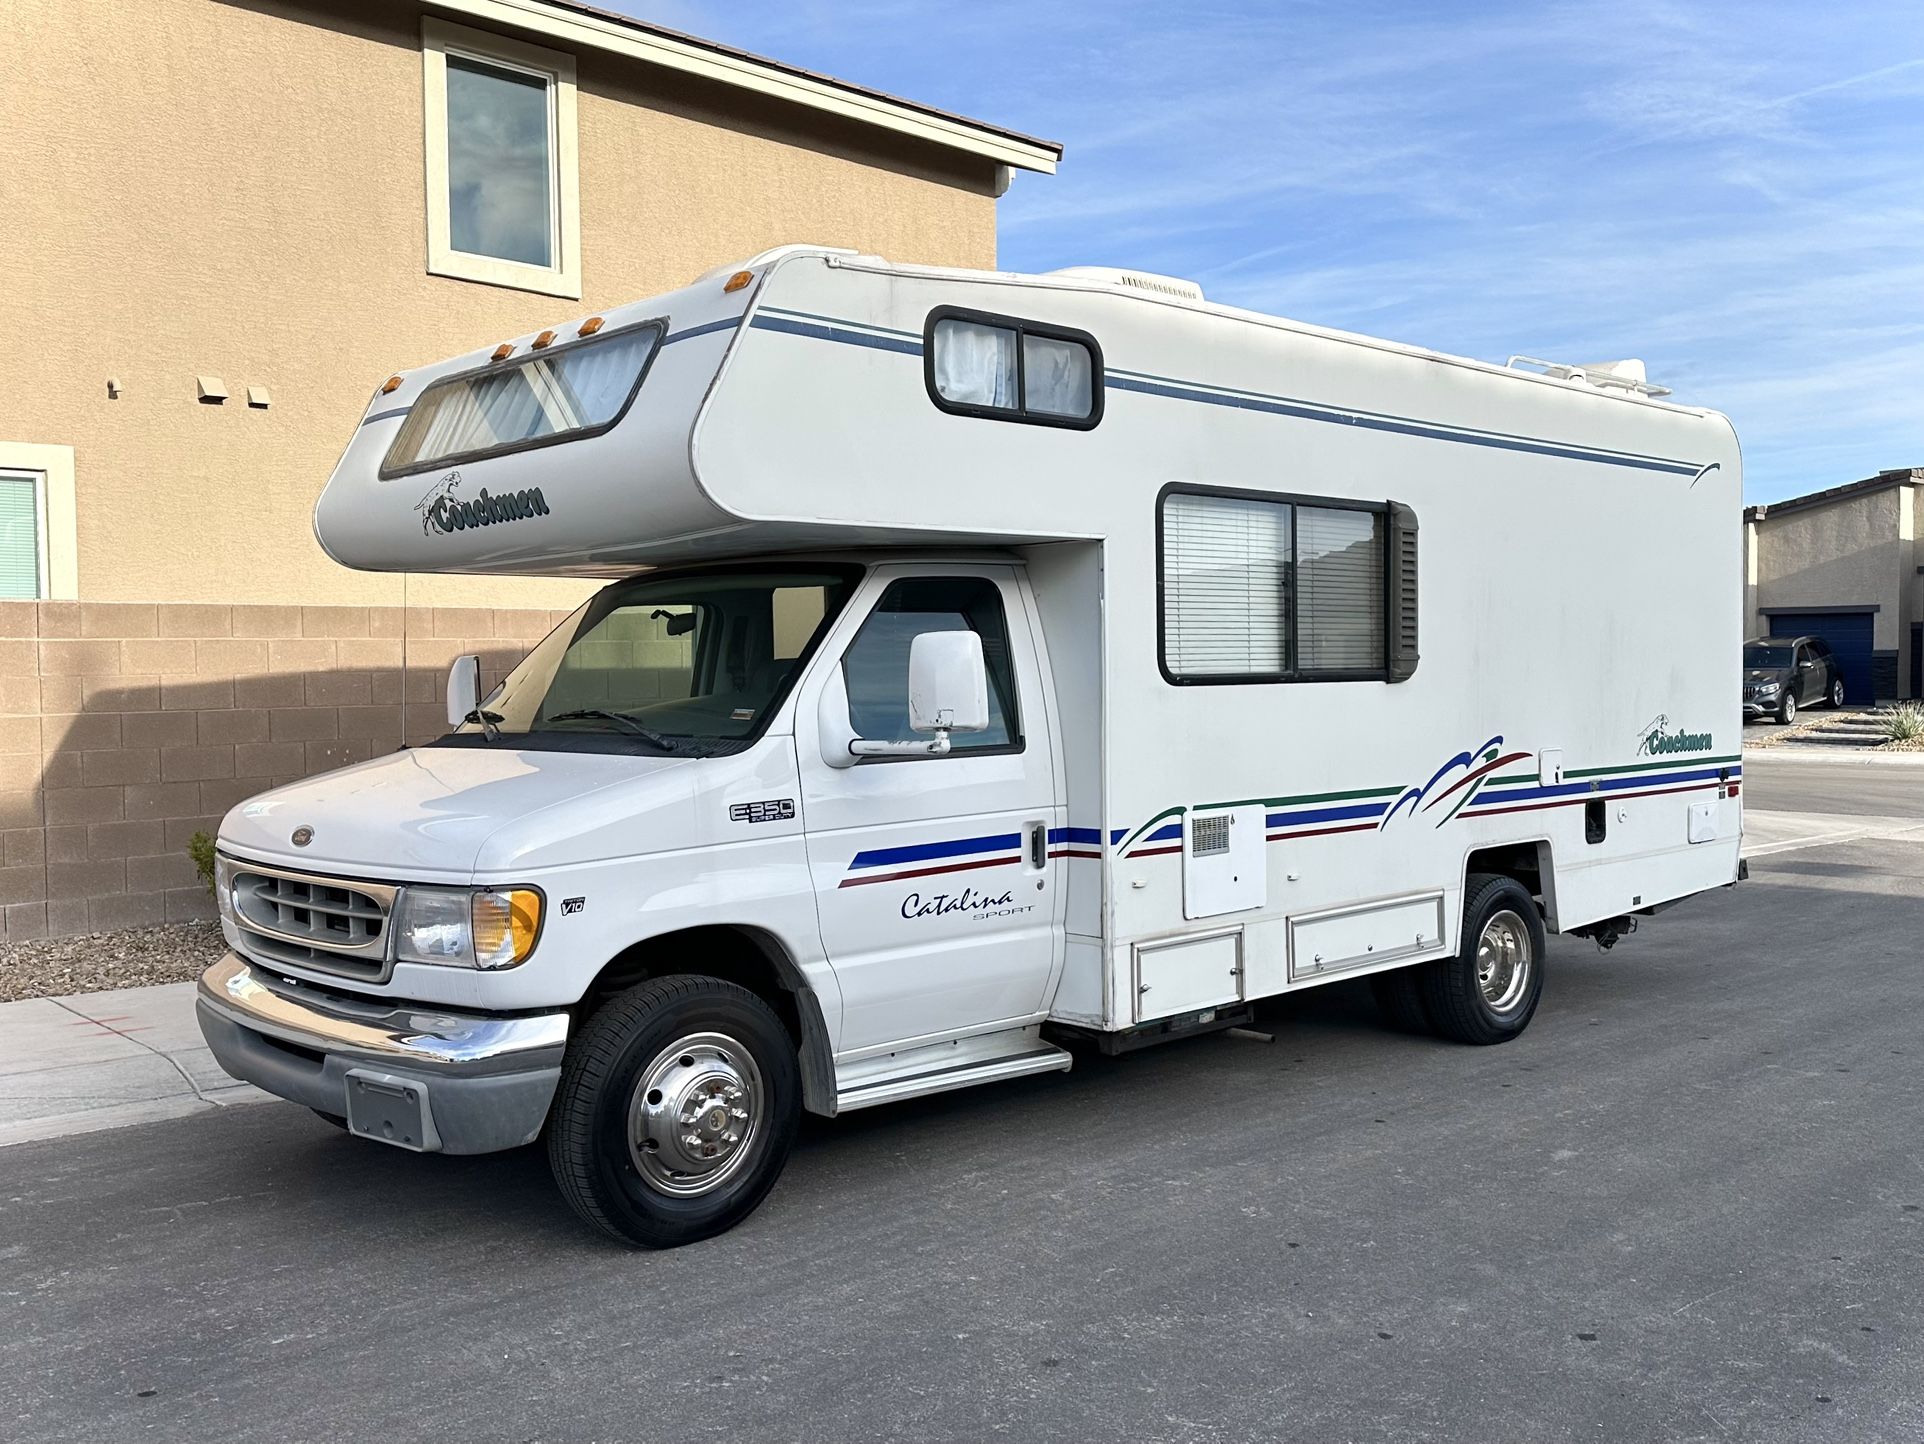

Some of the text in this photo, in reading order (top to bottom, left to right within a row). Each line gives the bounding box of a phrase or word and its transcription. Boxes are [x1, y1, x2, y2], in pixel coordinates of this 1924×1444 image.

[431, 487, 550, 533] Coachmen
[1648, 728, 1712, 755] Coachmen
[561, 902, 583, 916] V10
[901, 887, 1014, 919] Catalina
[972, 904, 1036, 921] SPORT
